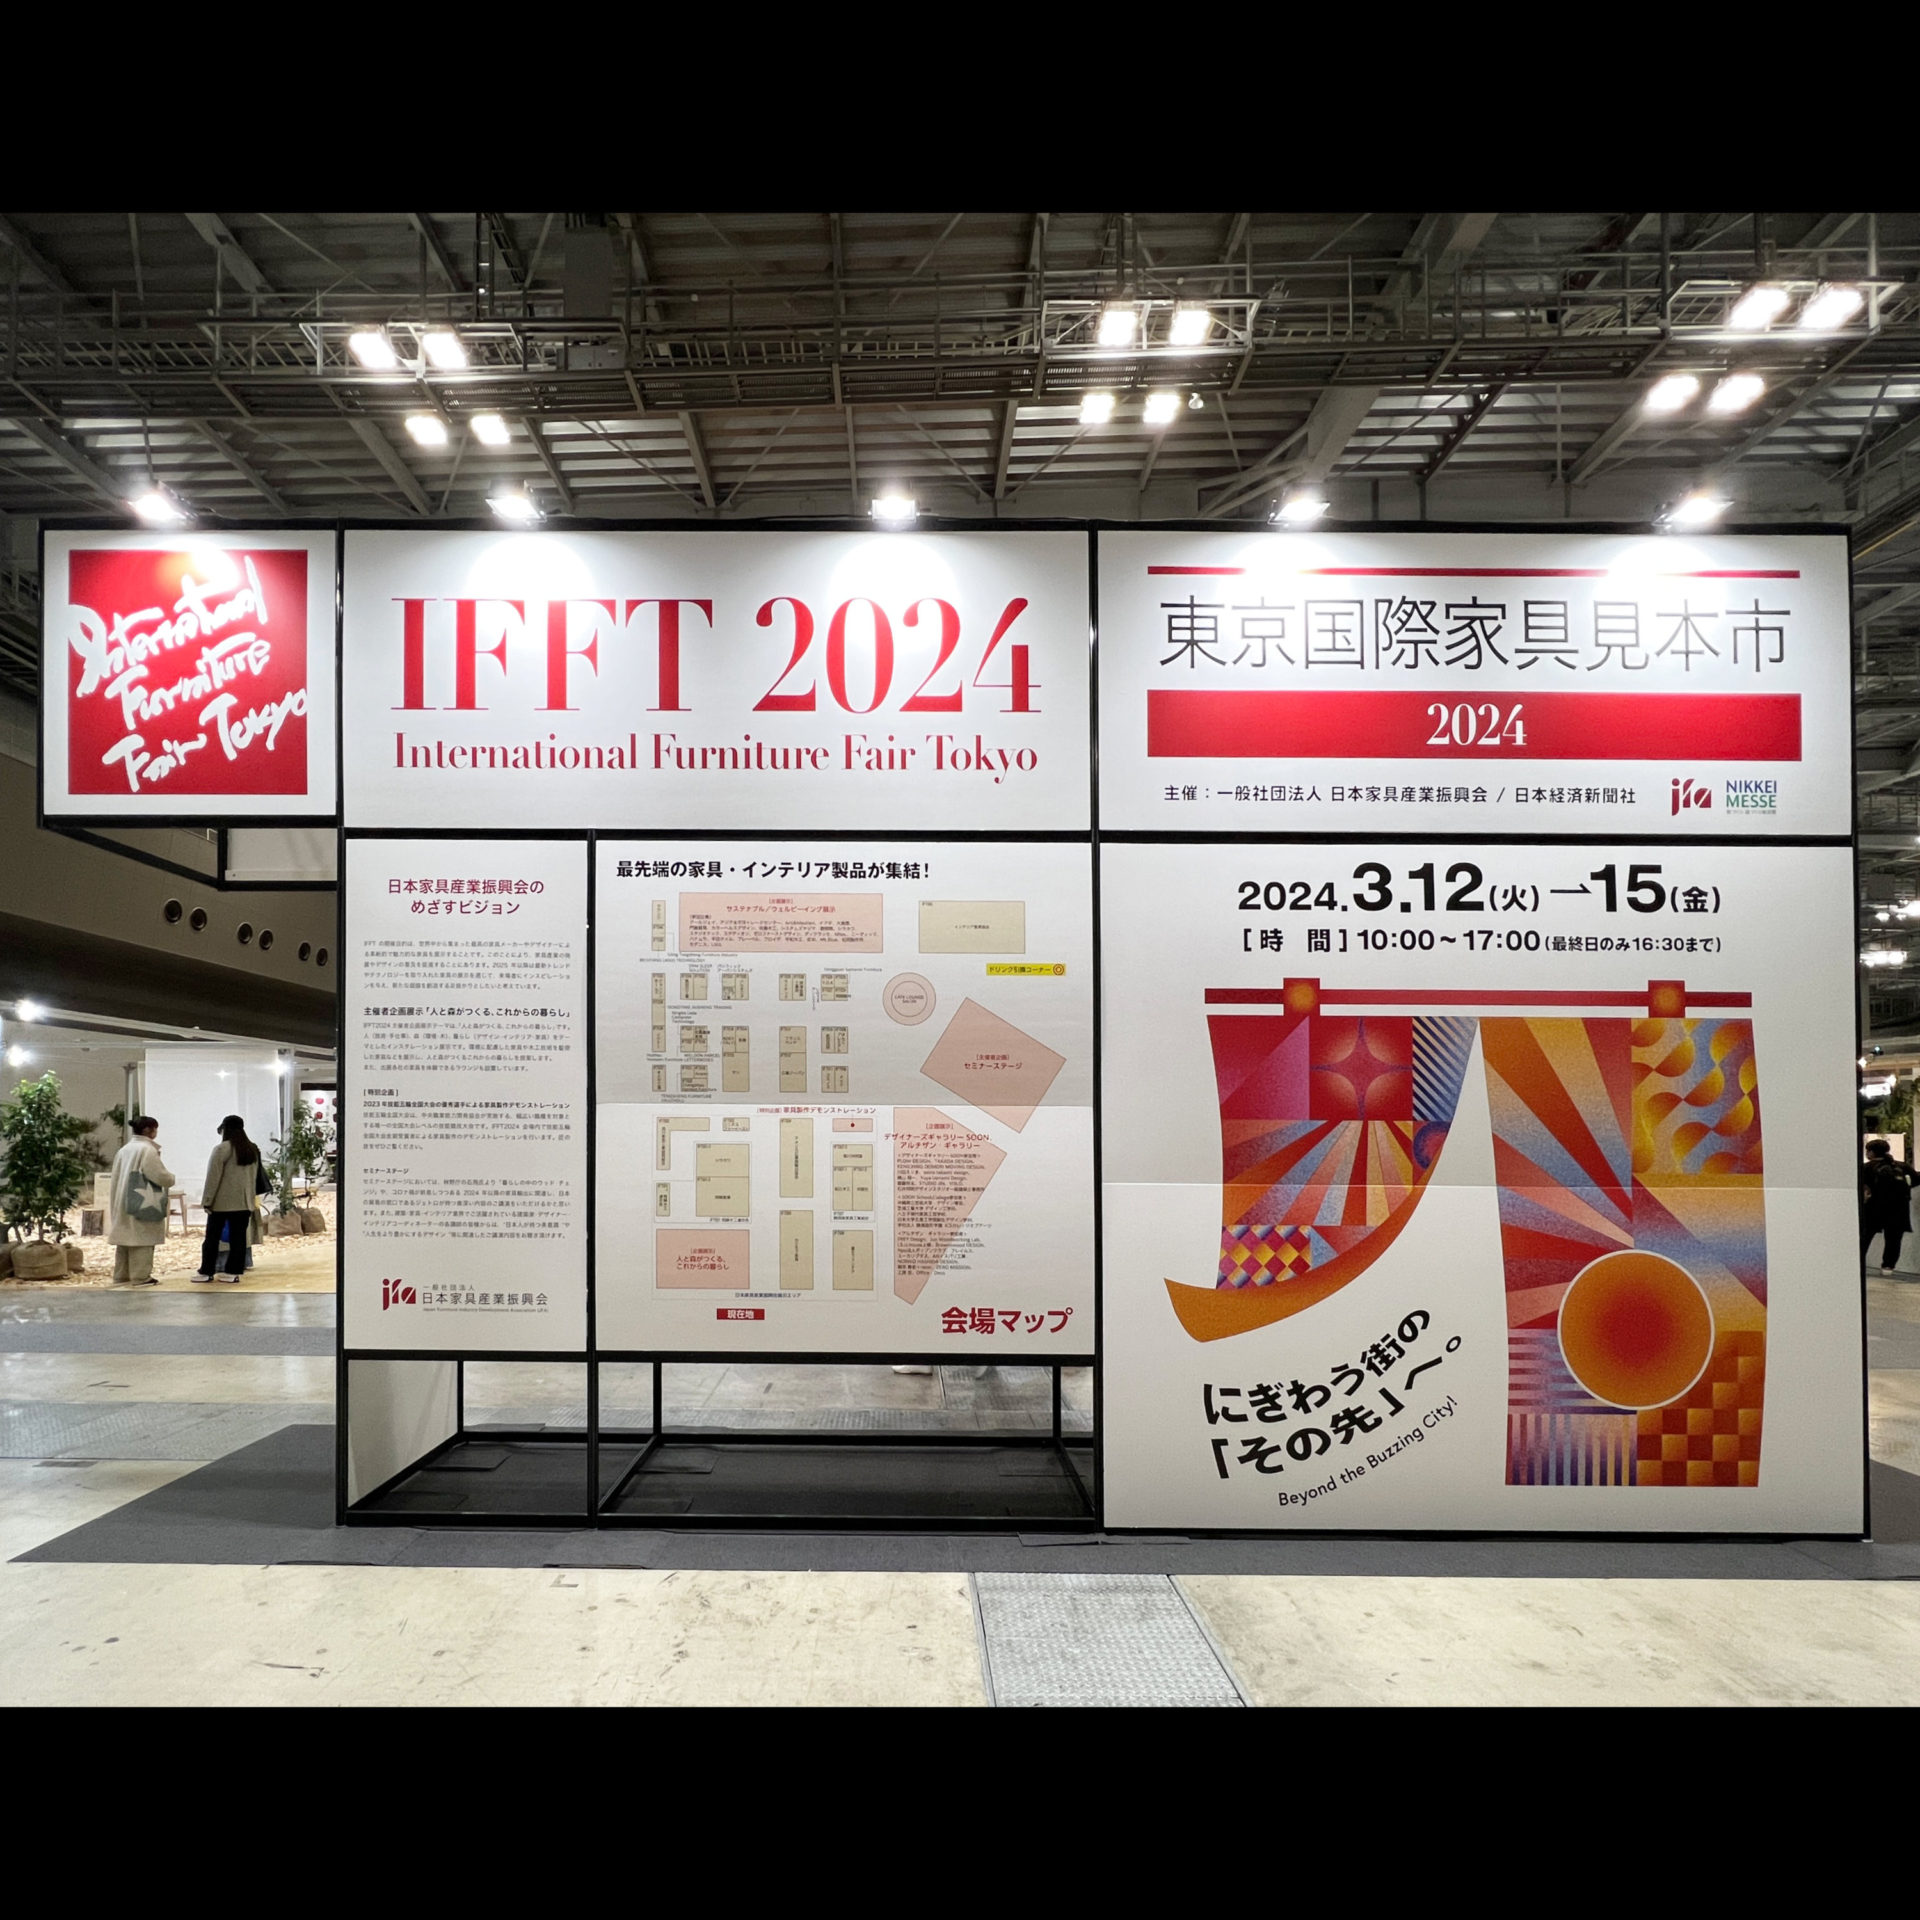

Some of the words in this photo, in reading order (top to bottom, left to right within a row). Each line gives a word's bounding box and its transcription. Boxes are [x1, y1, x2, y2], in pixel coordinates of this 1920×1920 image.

[1159, 595, 1792, 673] 東京国際家具見本市
[391, 598, 713, 712] IFFT
[752, 596, 1042, 714] 2024
[1425, 702, 1528, 748] 2024
[102, 733, 208, 793] Fair
[198, 688, 308, 761] Tokyo
[393, 732, 638, 771] International
[651, 733, 831, 771] Furniture
[841, 733, 917, 772] Fair
[925, 734, 1039, 785] Tokyo
[1331, 784, 1488, 804] 日本家具産業振興会
[1514, 785, 1638, 805] 日本経済新聞社
[1726, 779, 1777, 794] NIKKEI
[1726, 794, 1777, 808] MESSE
[616, 860, 929, 880] 最先端の家具・インテリア製品が集結！
[388, 878, 545, 896] 日本家具産業振興会の
[410, 899, 521, 916] めざすビジョン
[422, 1292, 549, 1306] 日本家具産業振興会
[727, 1309, 755, 1320] 現在地
[941, 1306, 1074, 1336] 会場マップ
[1203, 1309, 1431, 1426] にぎわう街の
[1278, 1476, 1338, 1507] Beyond
[1339, 1464, 1367, 1486] the
[1366, 1428, 1426, 1470] Buzzing
[1422, 1394, 1460, 1430] City!
